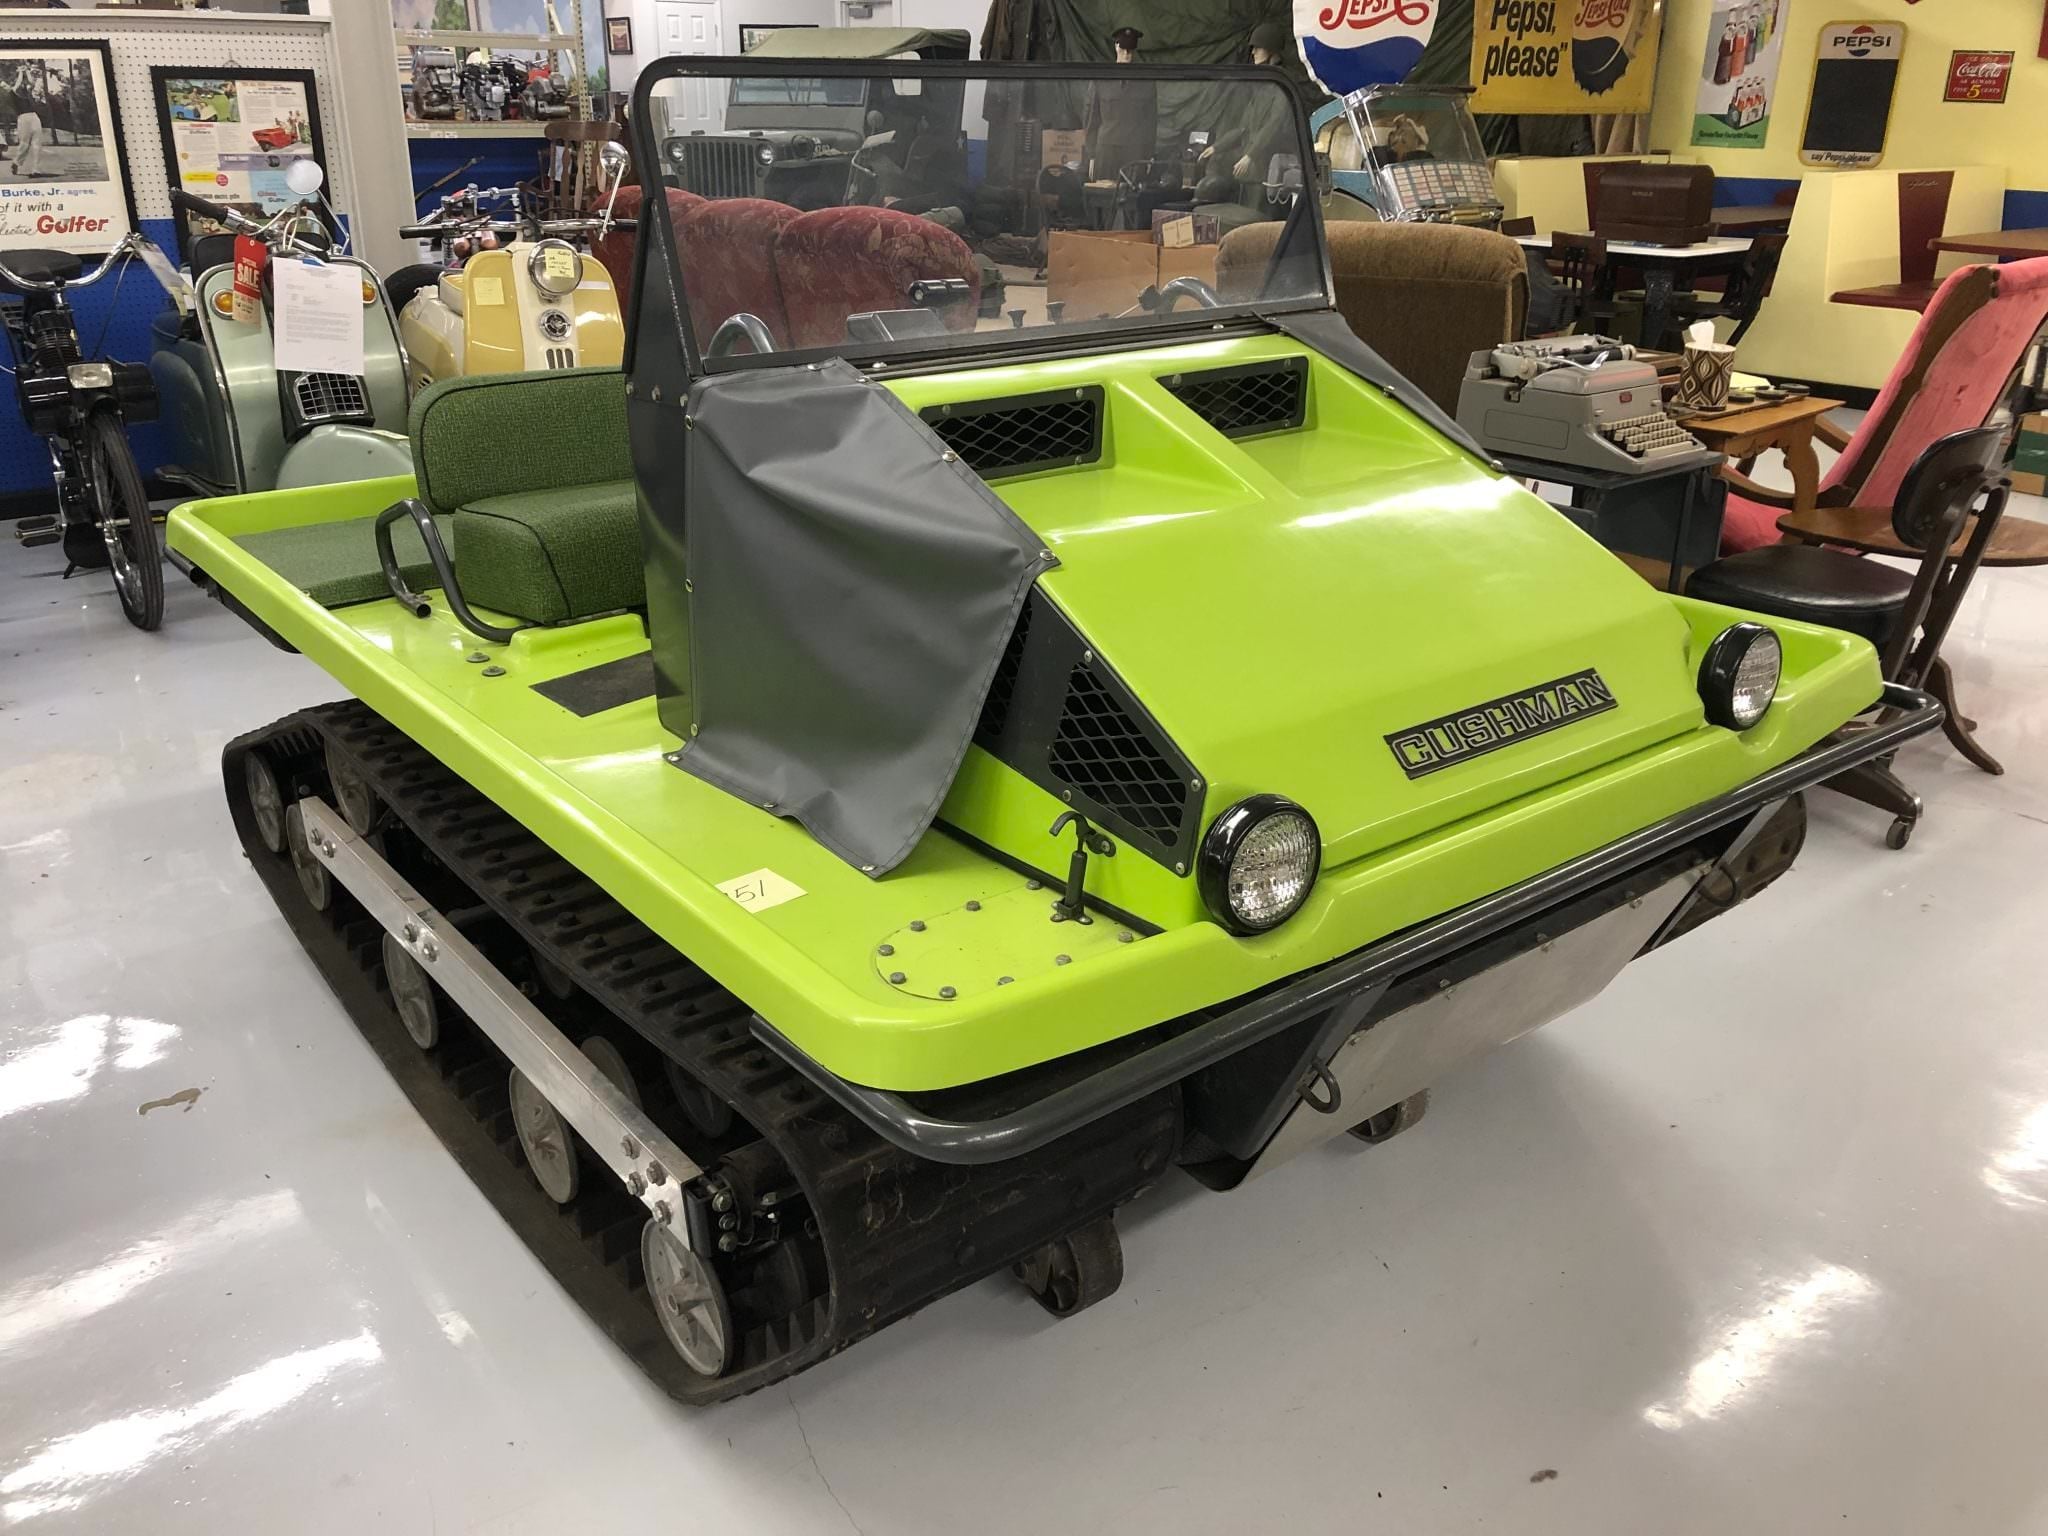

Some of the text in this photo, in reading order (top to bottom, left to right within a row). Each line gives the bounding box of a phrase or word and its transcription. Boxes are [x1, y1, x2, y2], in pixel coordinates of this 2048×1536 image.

[1833, 36, 1892, 47] PEPSI
[1966, 84, 1982, 98] 5
[47, 188, 64, 196] Jr.
[14, 203, 22, 212] it
[27, 202, 52, 212] with
[57, 203, 64, 211] a
[37, 215, 109, 234] Golfer
[237, 262, 260, 289] SALE
[1391, 673, 1615, 770] CUSHMAN
